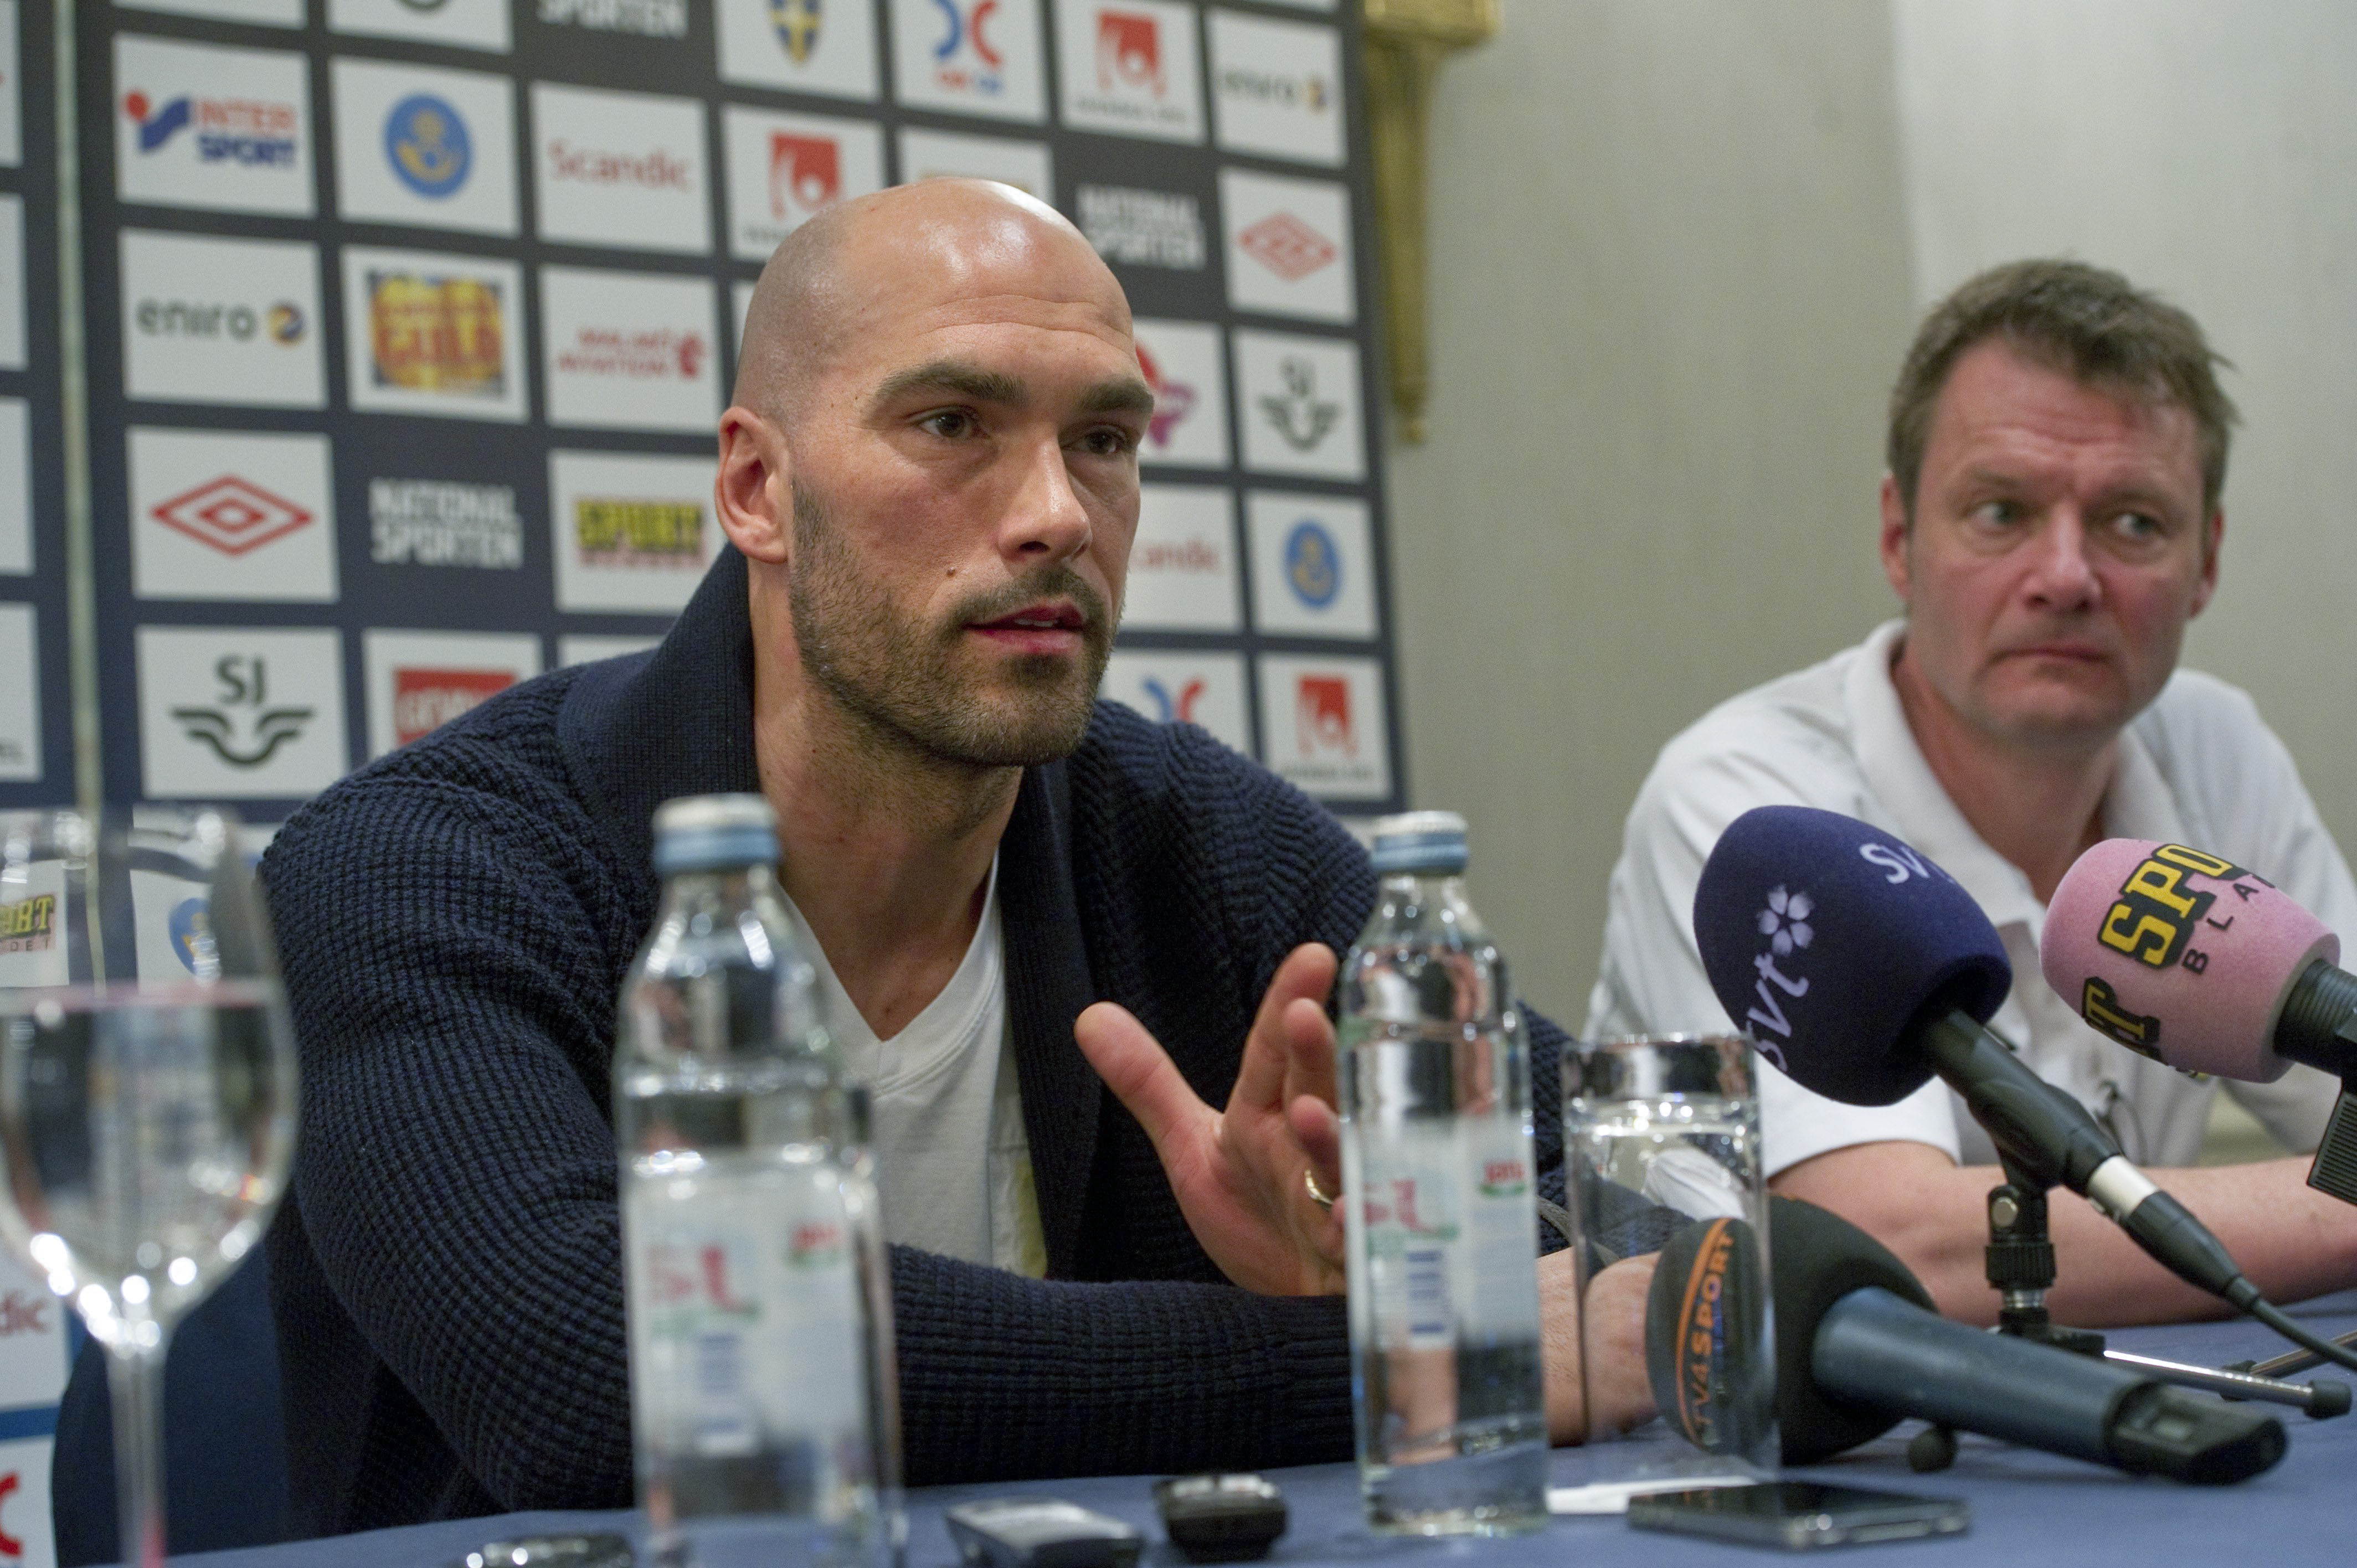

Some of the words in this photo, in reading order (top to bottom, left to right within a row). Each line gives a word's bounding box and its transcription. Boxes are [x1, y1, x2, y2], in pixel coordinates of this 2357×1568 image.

[136, 298, 256, 341] eniro
[215, 654, 265, 705] SJ
[2182, 875, 2275, 974] BLA
